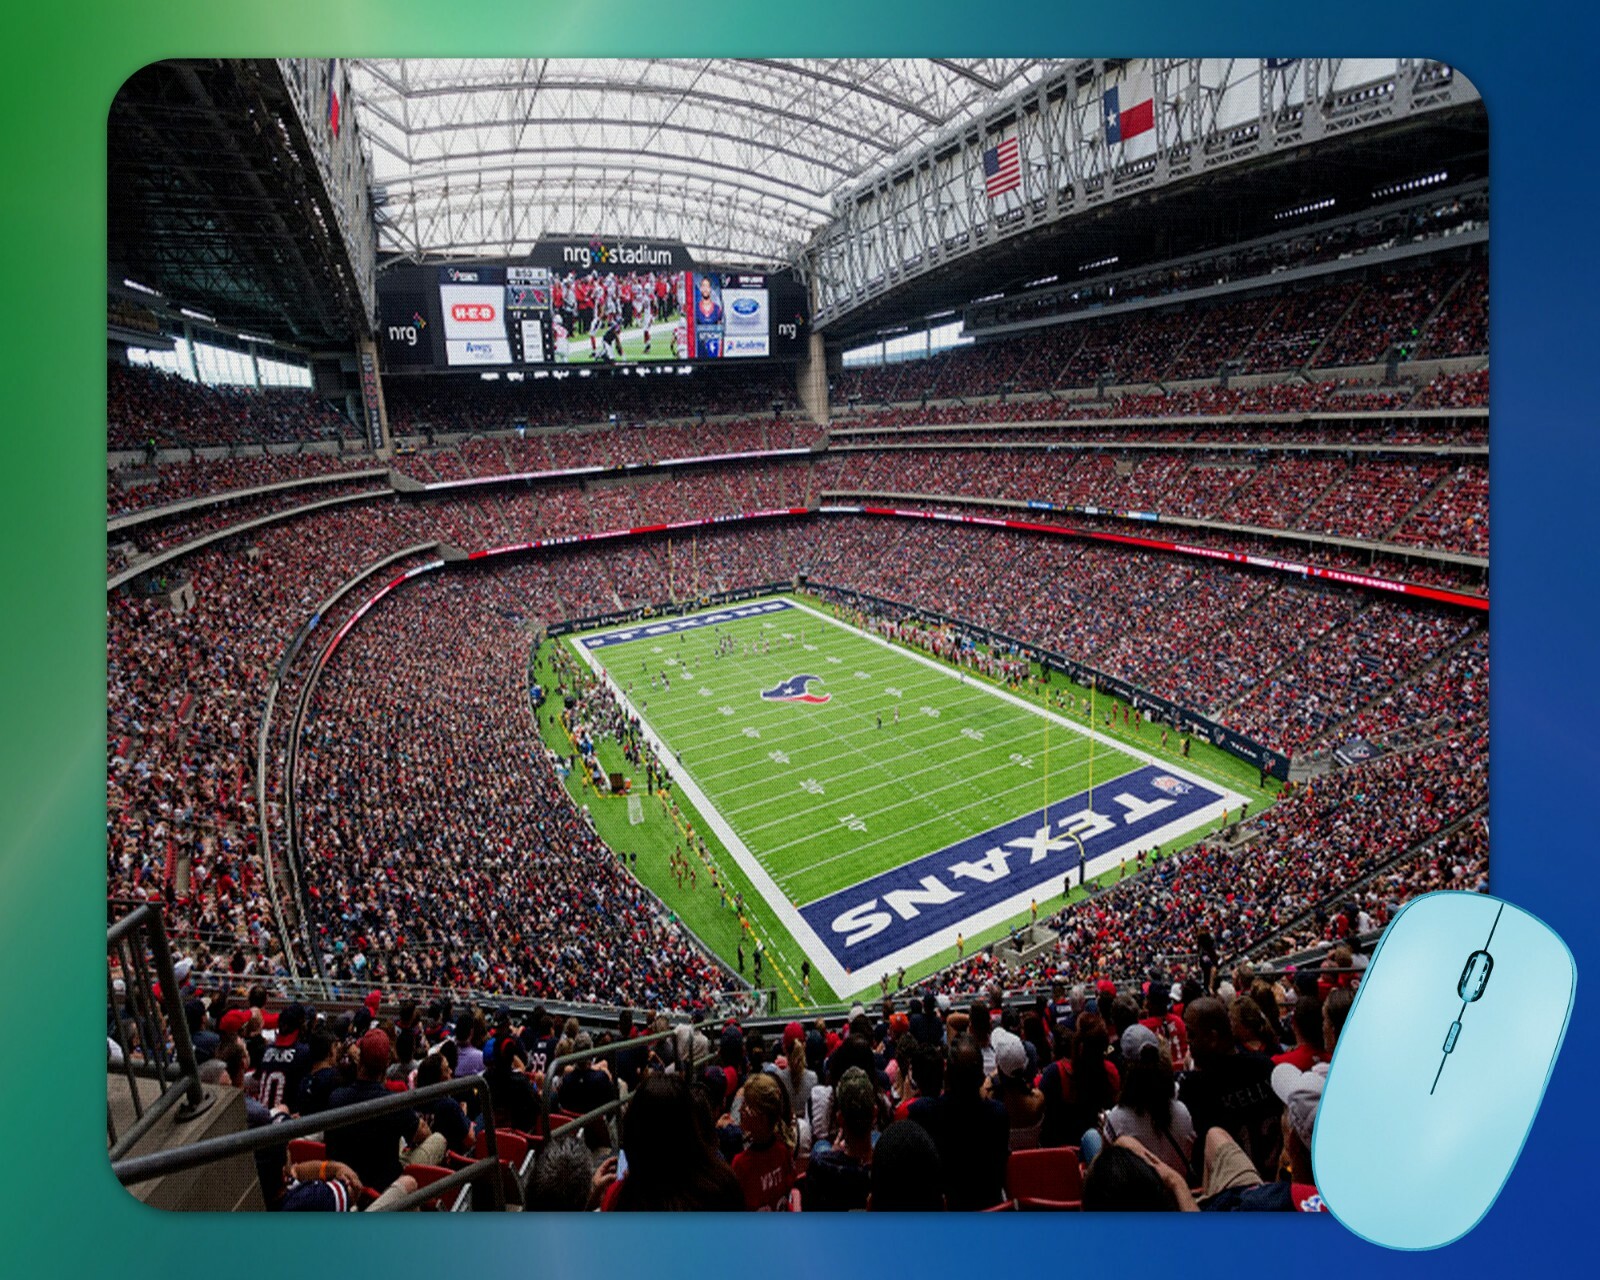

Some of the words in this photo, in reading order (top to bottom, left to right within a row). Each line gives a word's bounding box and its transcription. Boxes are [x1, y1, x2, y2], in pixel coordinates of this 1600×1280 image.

[564, 247, 591, 268] nrg
[609, 245, 672, 265] stadium
[388, 326, 418, 346] nrg
[779, 323, 797, 340] nrg
[831, 792, 1176, 948] TEXANS
